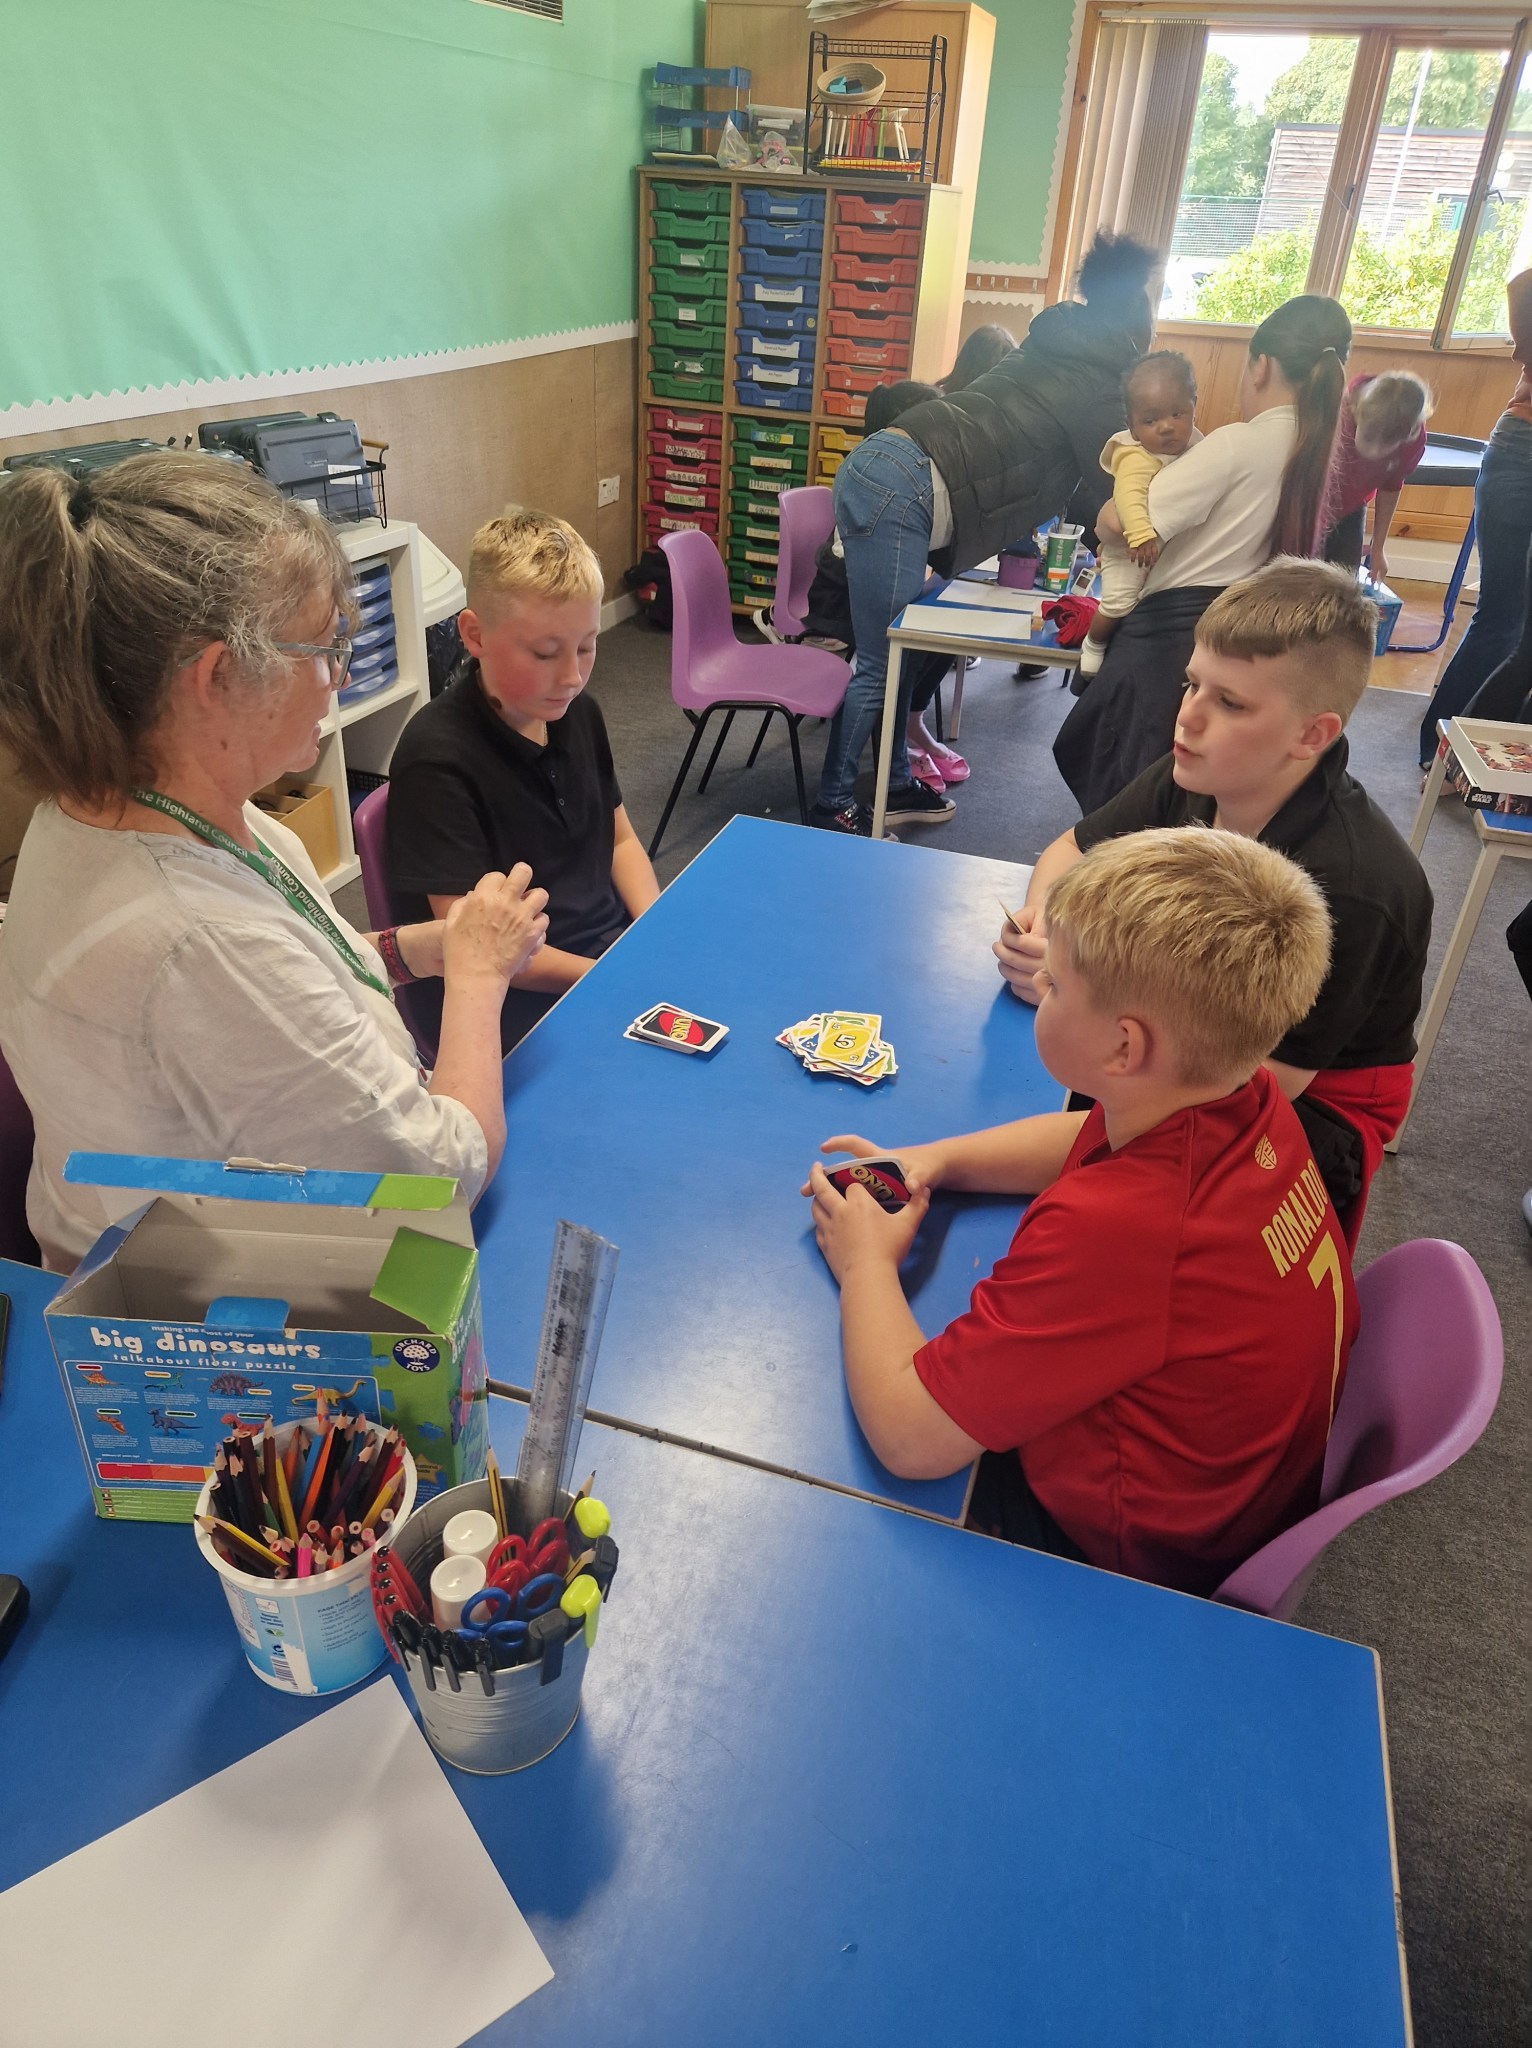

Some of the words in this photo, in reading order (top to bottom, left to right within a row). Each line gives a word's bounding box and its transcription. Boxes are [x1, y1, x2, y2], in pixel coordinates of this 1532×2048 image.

[155, 796, 210, 833] Highland
[211, 828, 248, 858] Council
[296, 890, 334, 932] Highland
[833, 1033, 857, 1049] 5
[151, 1325, 183, 1334] making
[1307, 1230, 1344, 1441] 7
[90, 1327, 143, 1354] big
[156, 1332, 321, 1359] dinosaurs
[395, 1338, 437, 1355] ORCHARD
[113, 1354, 191, 1366] talkabout
[198, 1358, 238, 1368] floor
[245, 1361, 297, 1371] puzzle
[406, 1363, 431, 1372] TOYS
